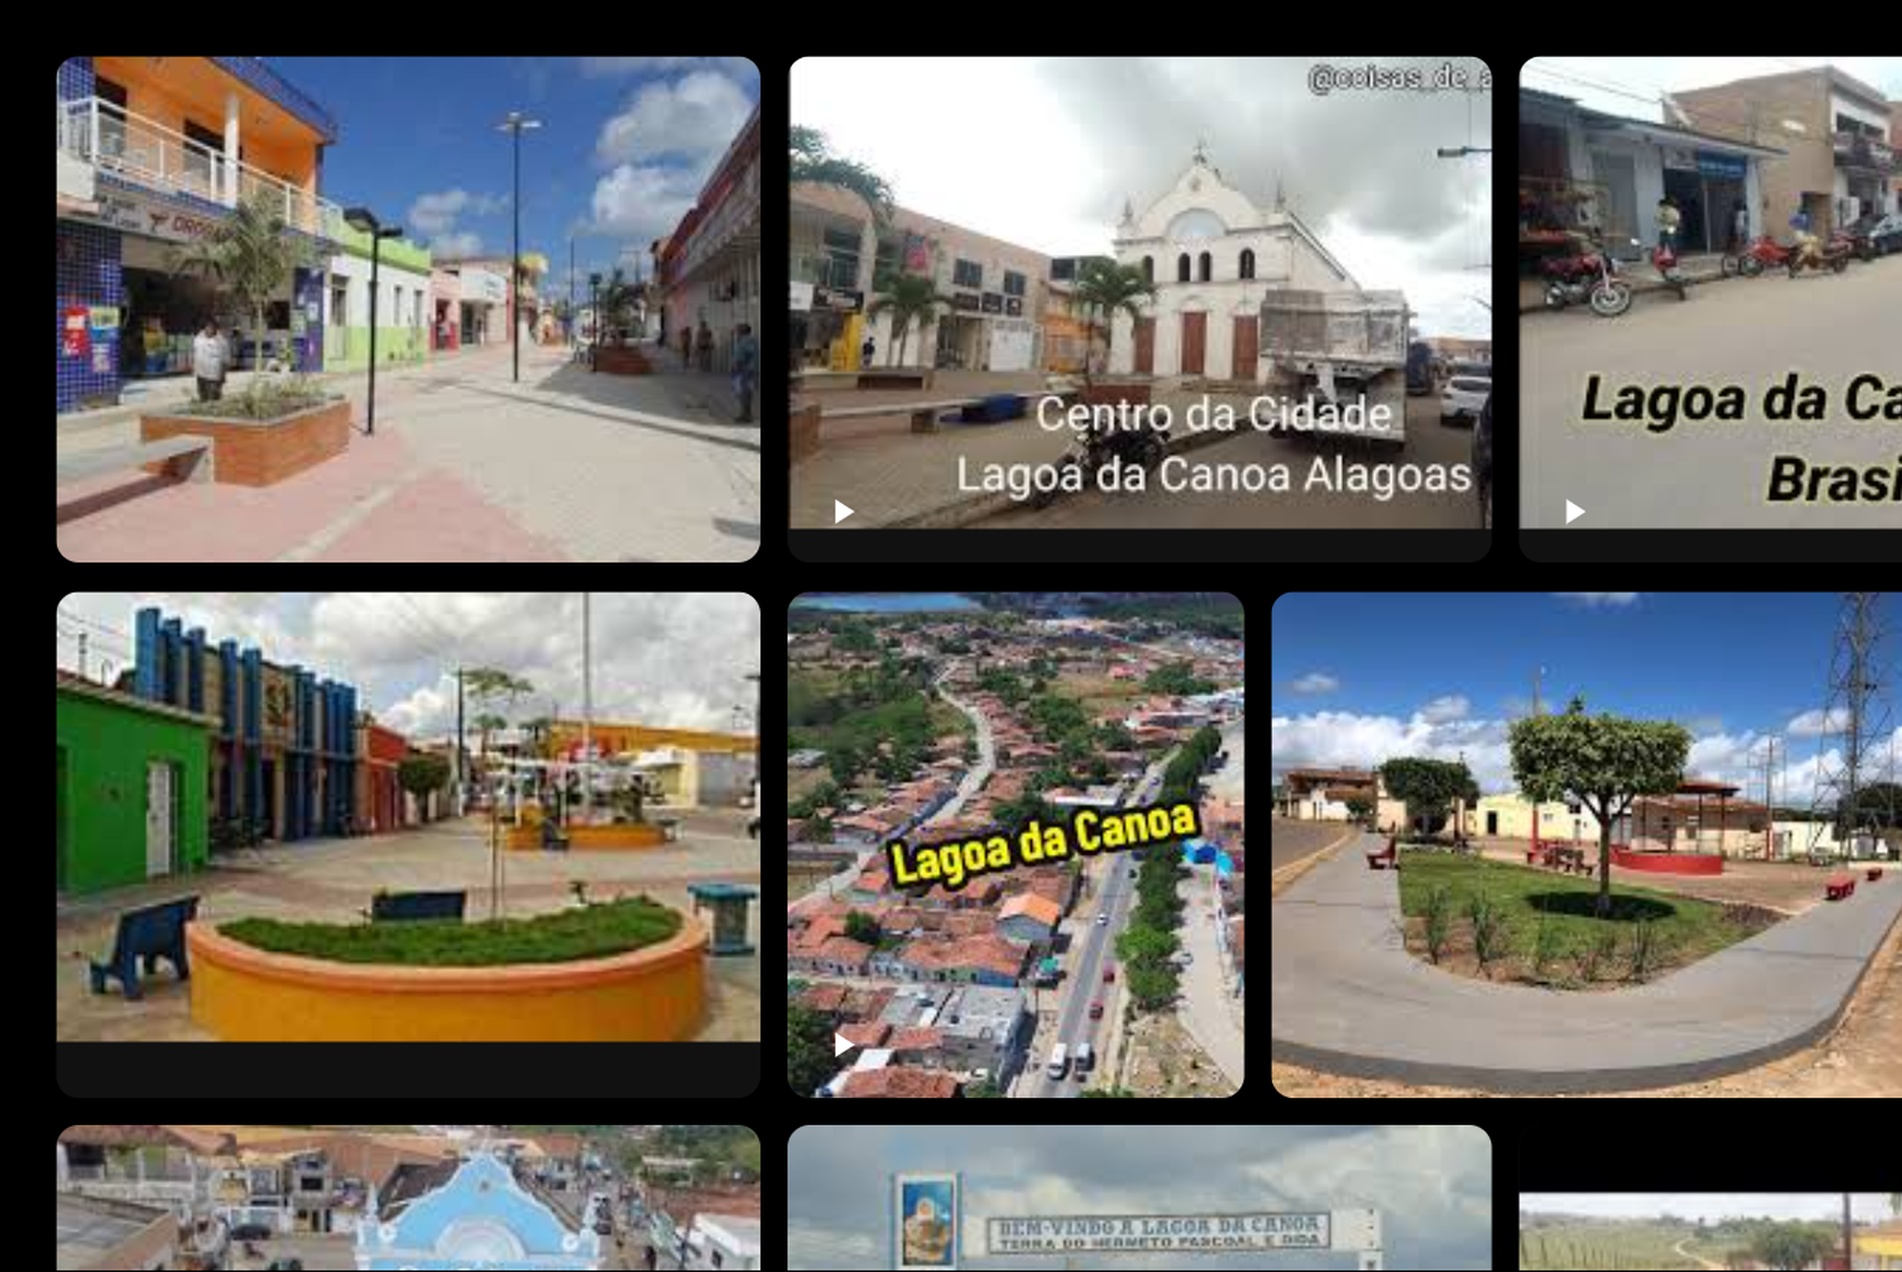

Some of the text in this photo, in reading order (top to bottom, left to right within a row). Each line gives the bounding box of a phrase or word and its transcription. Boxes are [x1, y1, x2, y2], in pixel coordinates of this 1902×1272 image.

[999, 1216, 1319, 1236] BEM-VINDO A LAGOA DA CANOA
[1000, 1239, 1056, 1250] TERRA
